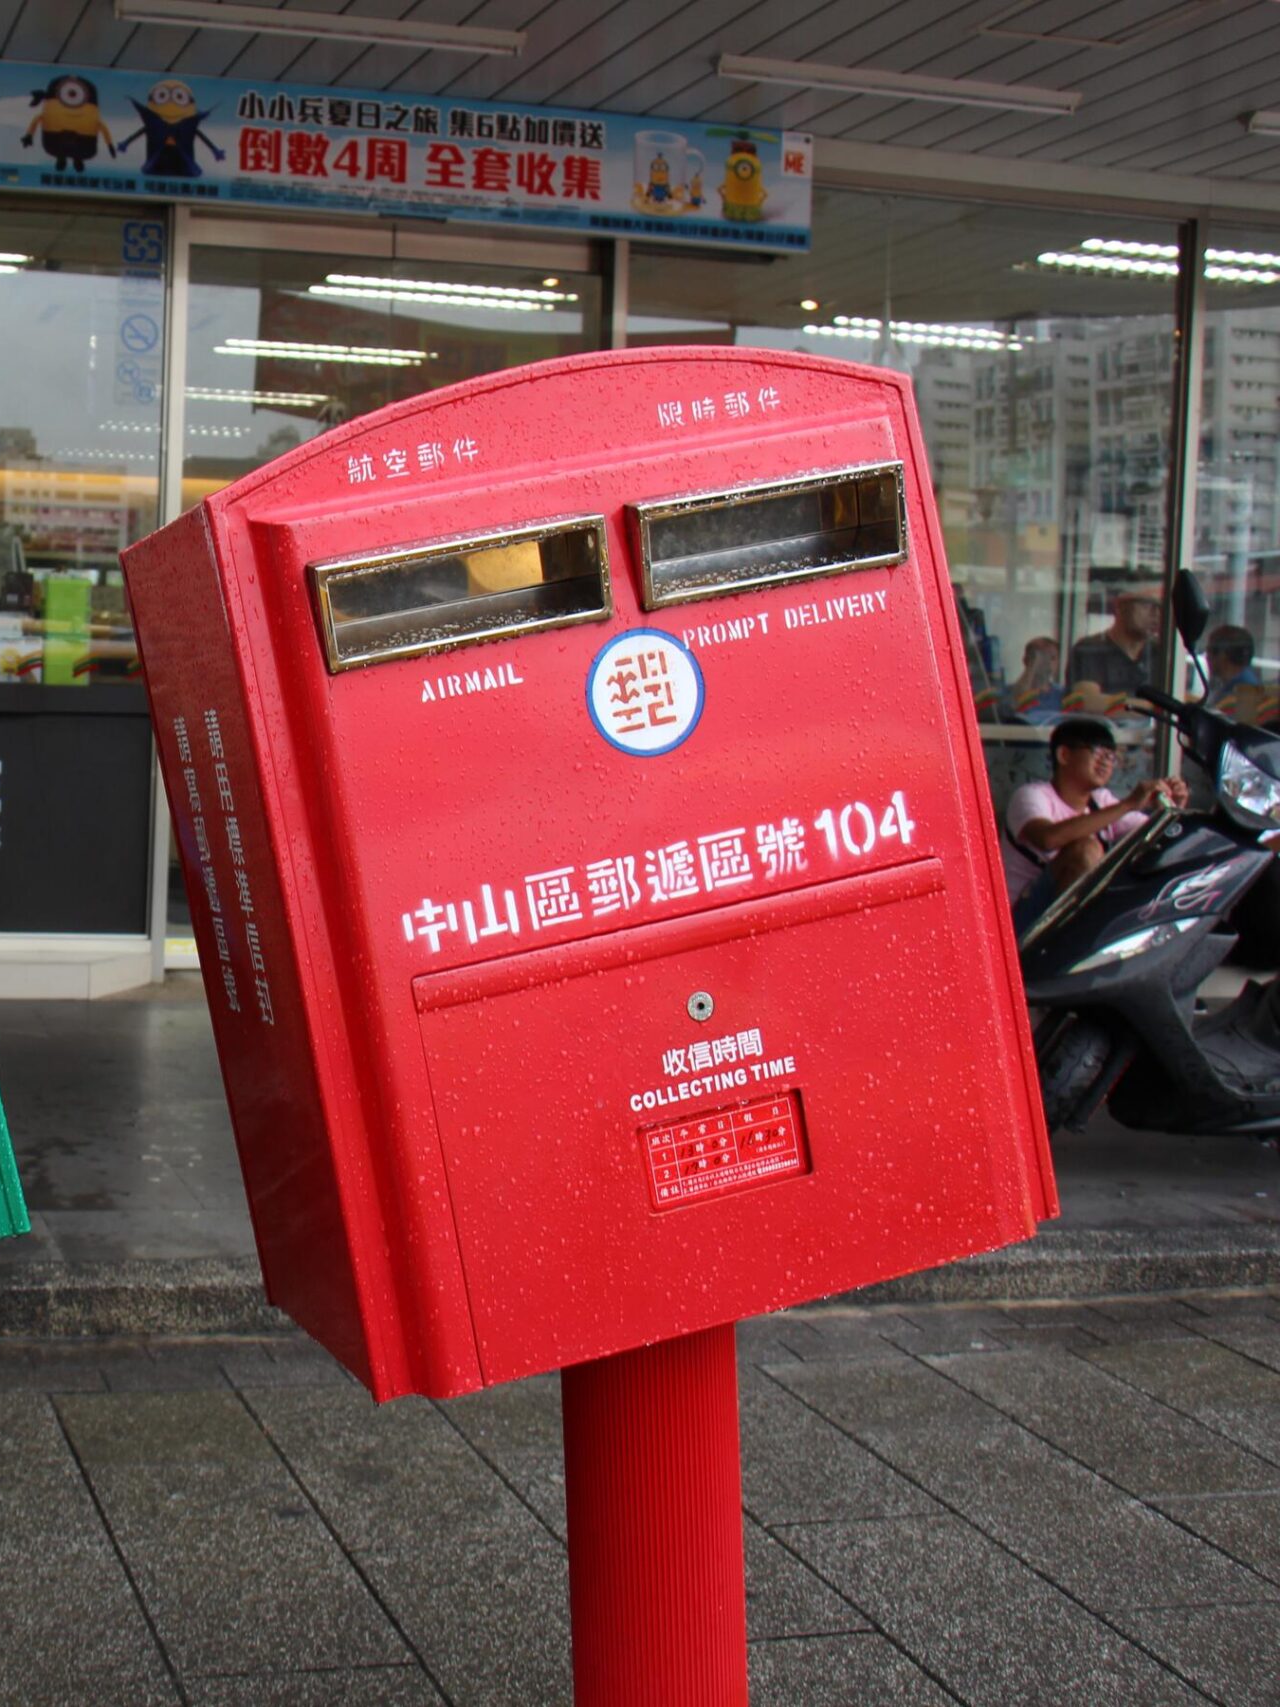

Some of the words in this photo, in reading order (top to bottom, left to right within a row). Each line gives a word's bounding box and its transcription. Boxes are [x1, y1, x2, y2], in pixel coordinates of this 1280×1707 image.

[239, 92, 438, 134] 小小兵夏日之旅
[238, 127, 410, 184] 倒數4周
[424, 142, 602, 200] 全套收集
[657, 386, 781, 428] 限時郵件
[347, 437, 479, 484] 航空郵件
[682, 612, 769, 650] PROMPT
[784, 589, 887, 630] DELIVERY
[421, 663, 524, 703] AIRMAIL
[662, 1028, 764, 1077] 收信時間
[630, 1069, 747, 1112] COLLECTING
[750, 1056, 796, 1081] TIME
